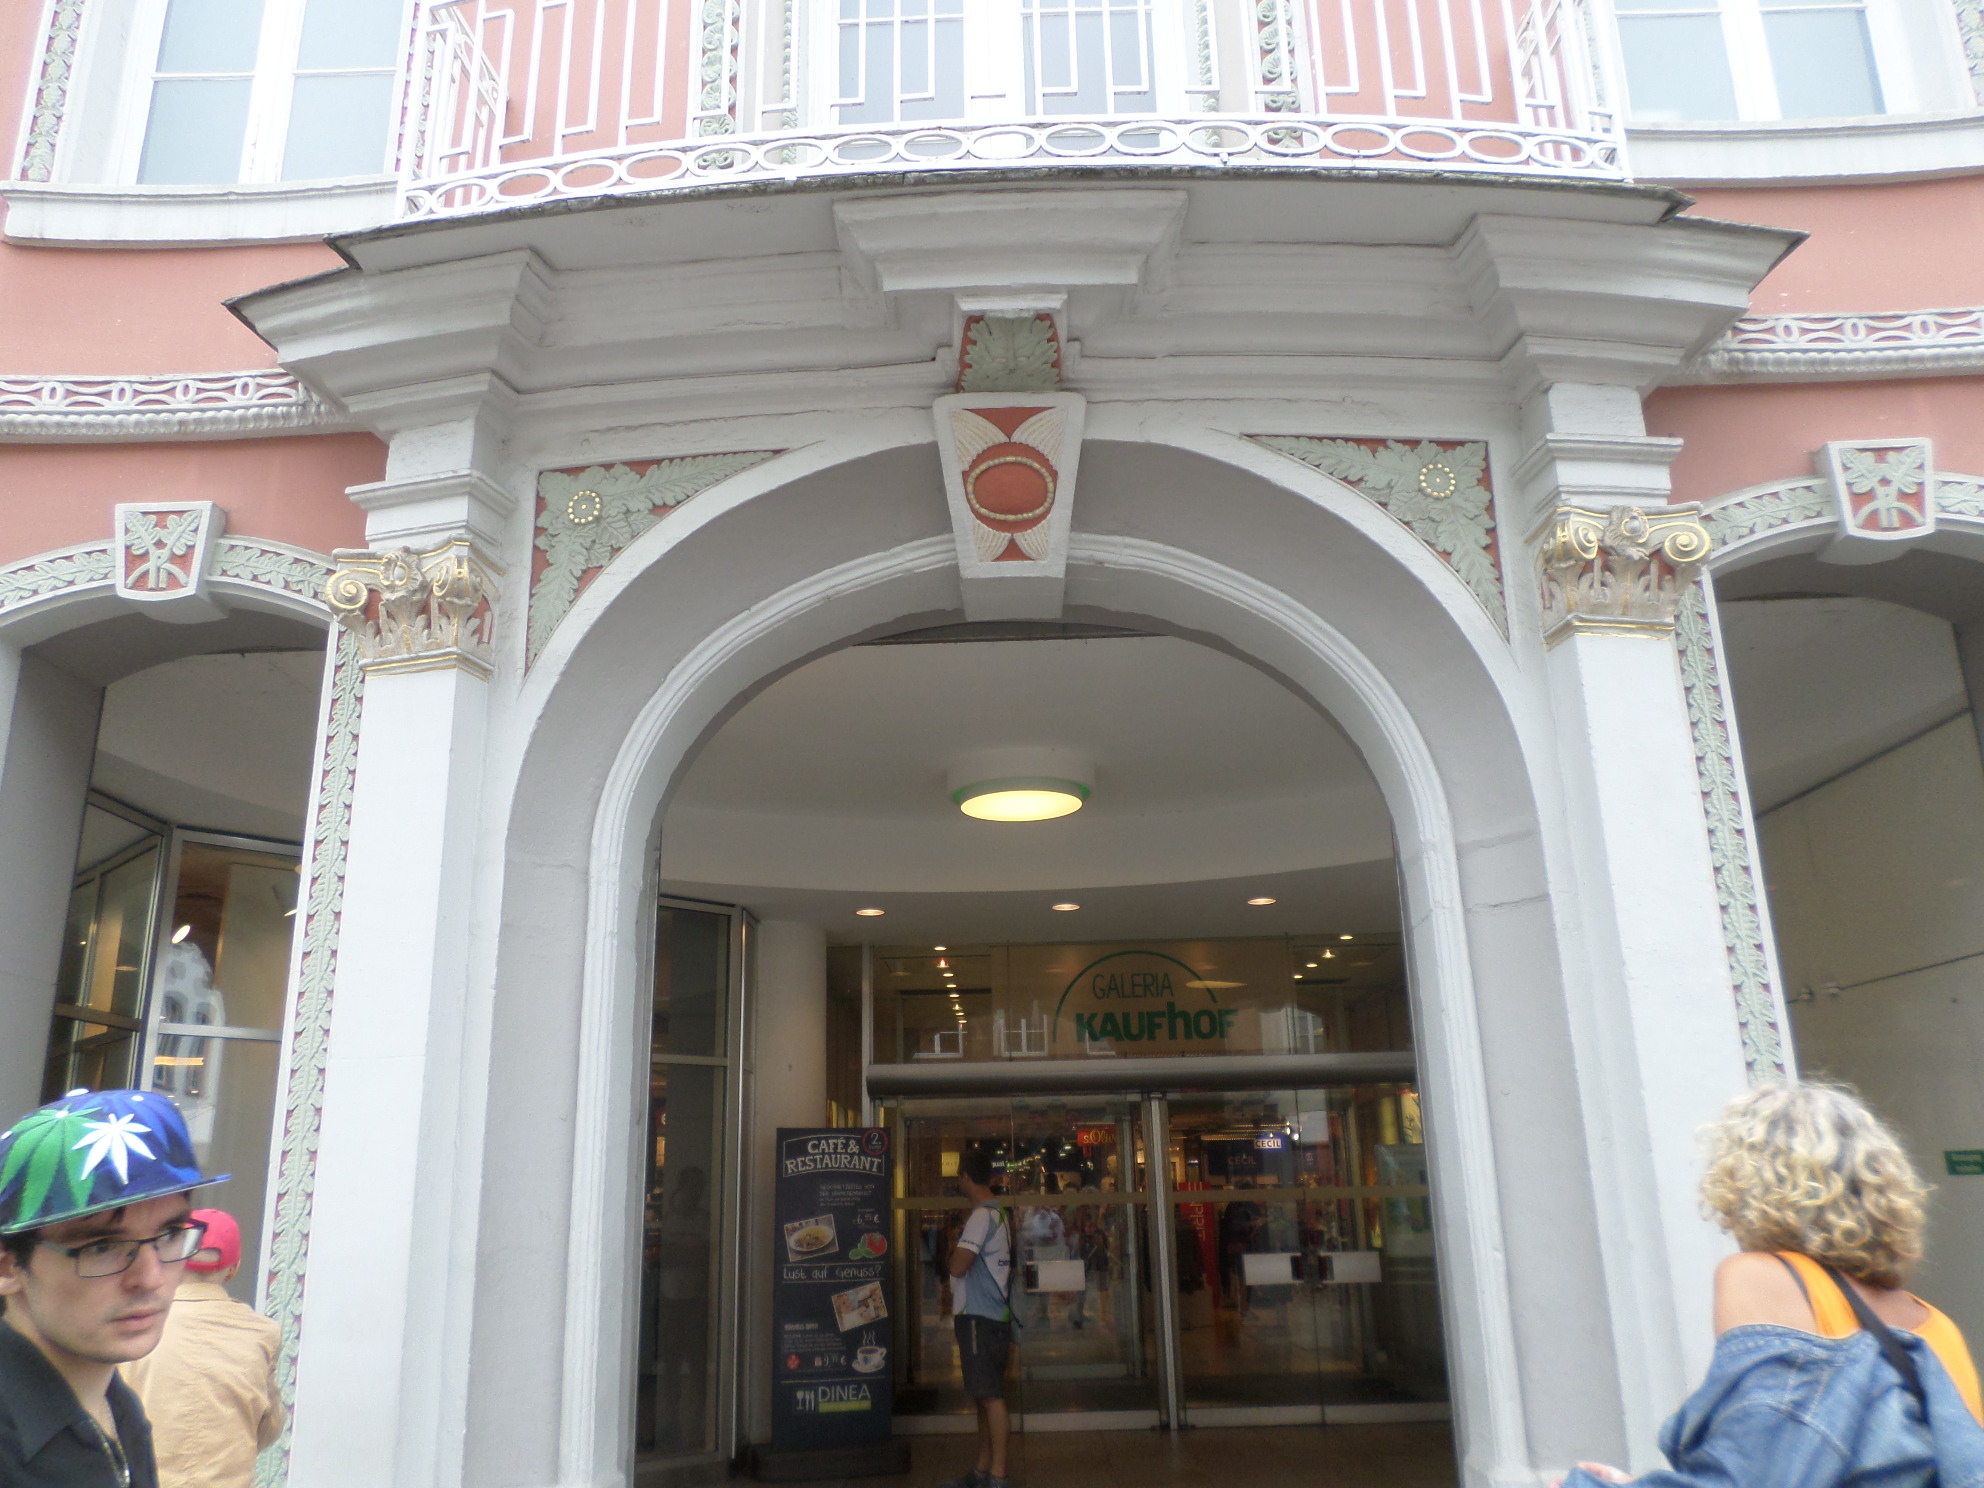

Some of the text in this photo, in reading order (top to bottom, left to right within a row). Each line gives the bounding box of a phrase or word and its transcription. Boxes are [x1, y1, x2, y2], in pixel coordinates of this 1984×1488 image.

[1092, 972, 1174, 999] GALERIA
[807, 1137, 845, 1153] CAFÉ
[848, 1140, 859, 1153] &
[786, 1154, 882, 1174] RESTAURANT
[783, 1265, 881, 1279] Lust auf Genuss?
[818, 1384, 871, 1401] DINEA
